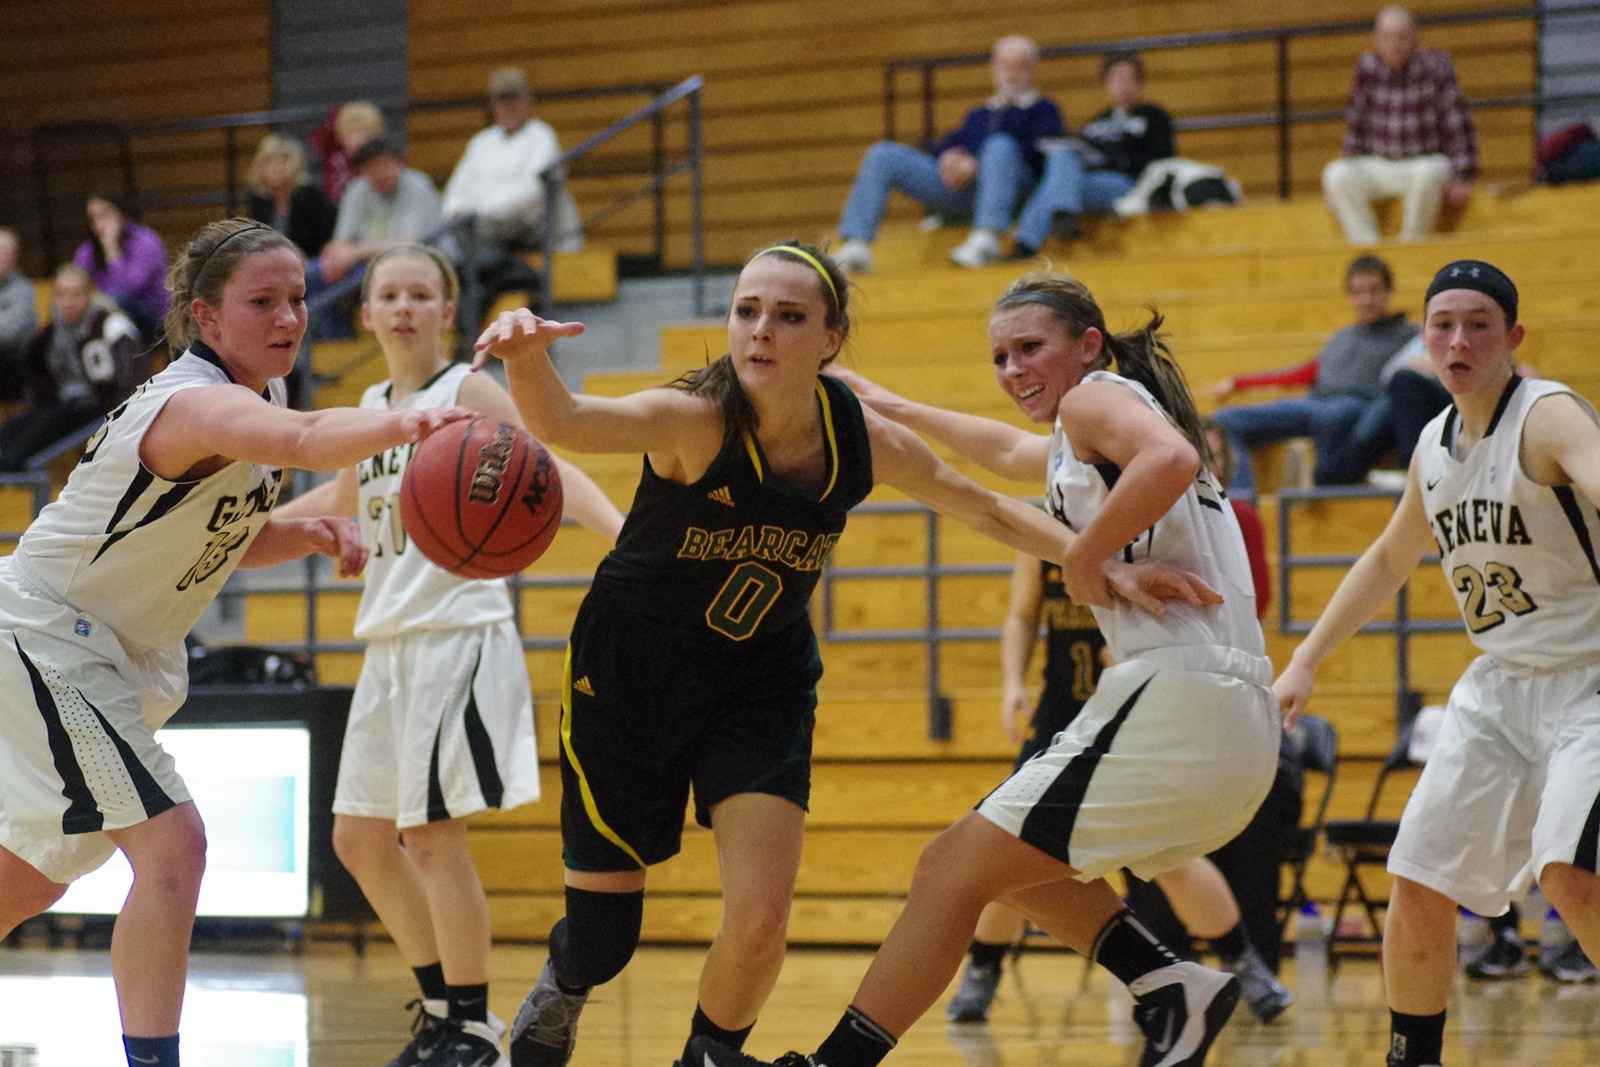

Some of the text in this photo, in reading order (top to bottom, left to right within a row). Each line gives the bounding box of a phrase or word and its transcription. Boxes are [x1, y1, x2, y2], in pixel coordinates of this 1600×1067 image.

[1430, 498, 1533, 559] ENEVA
[705, 561, 783, 641] 0
[1452, 561, 1539, 634] 23
